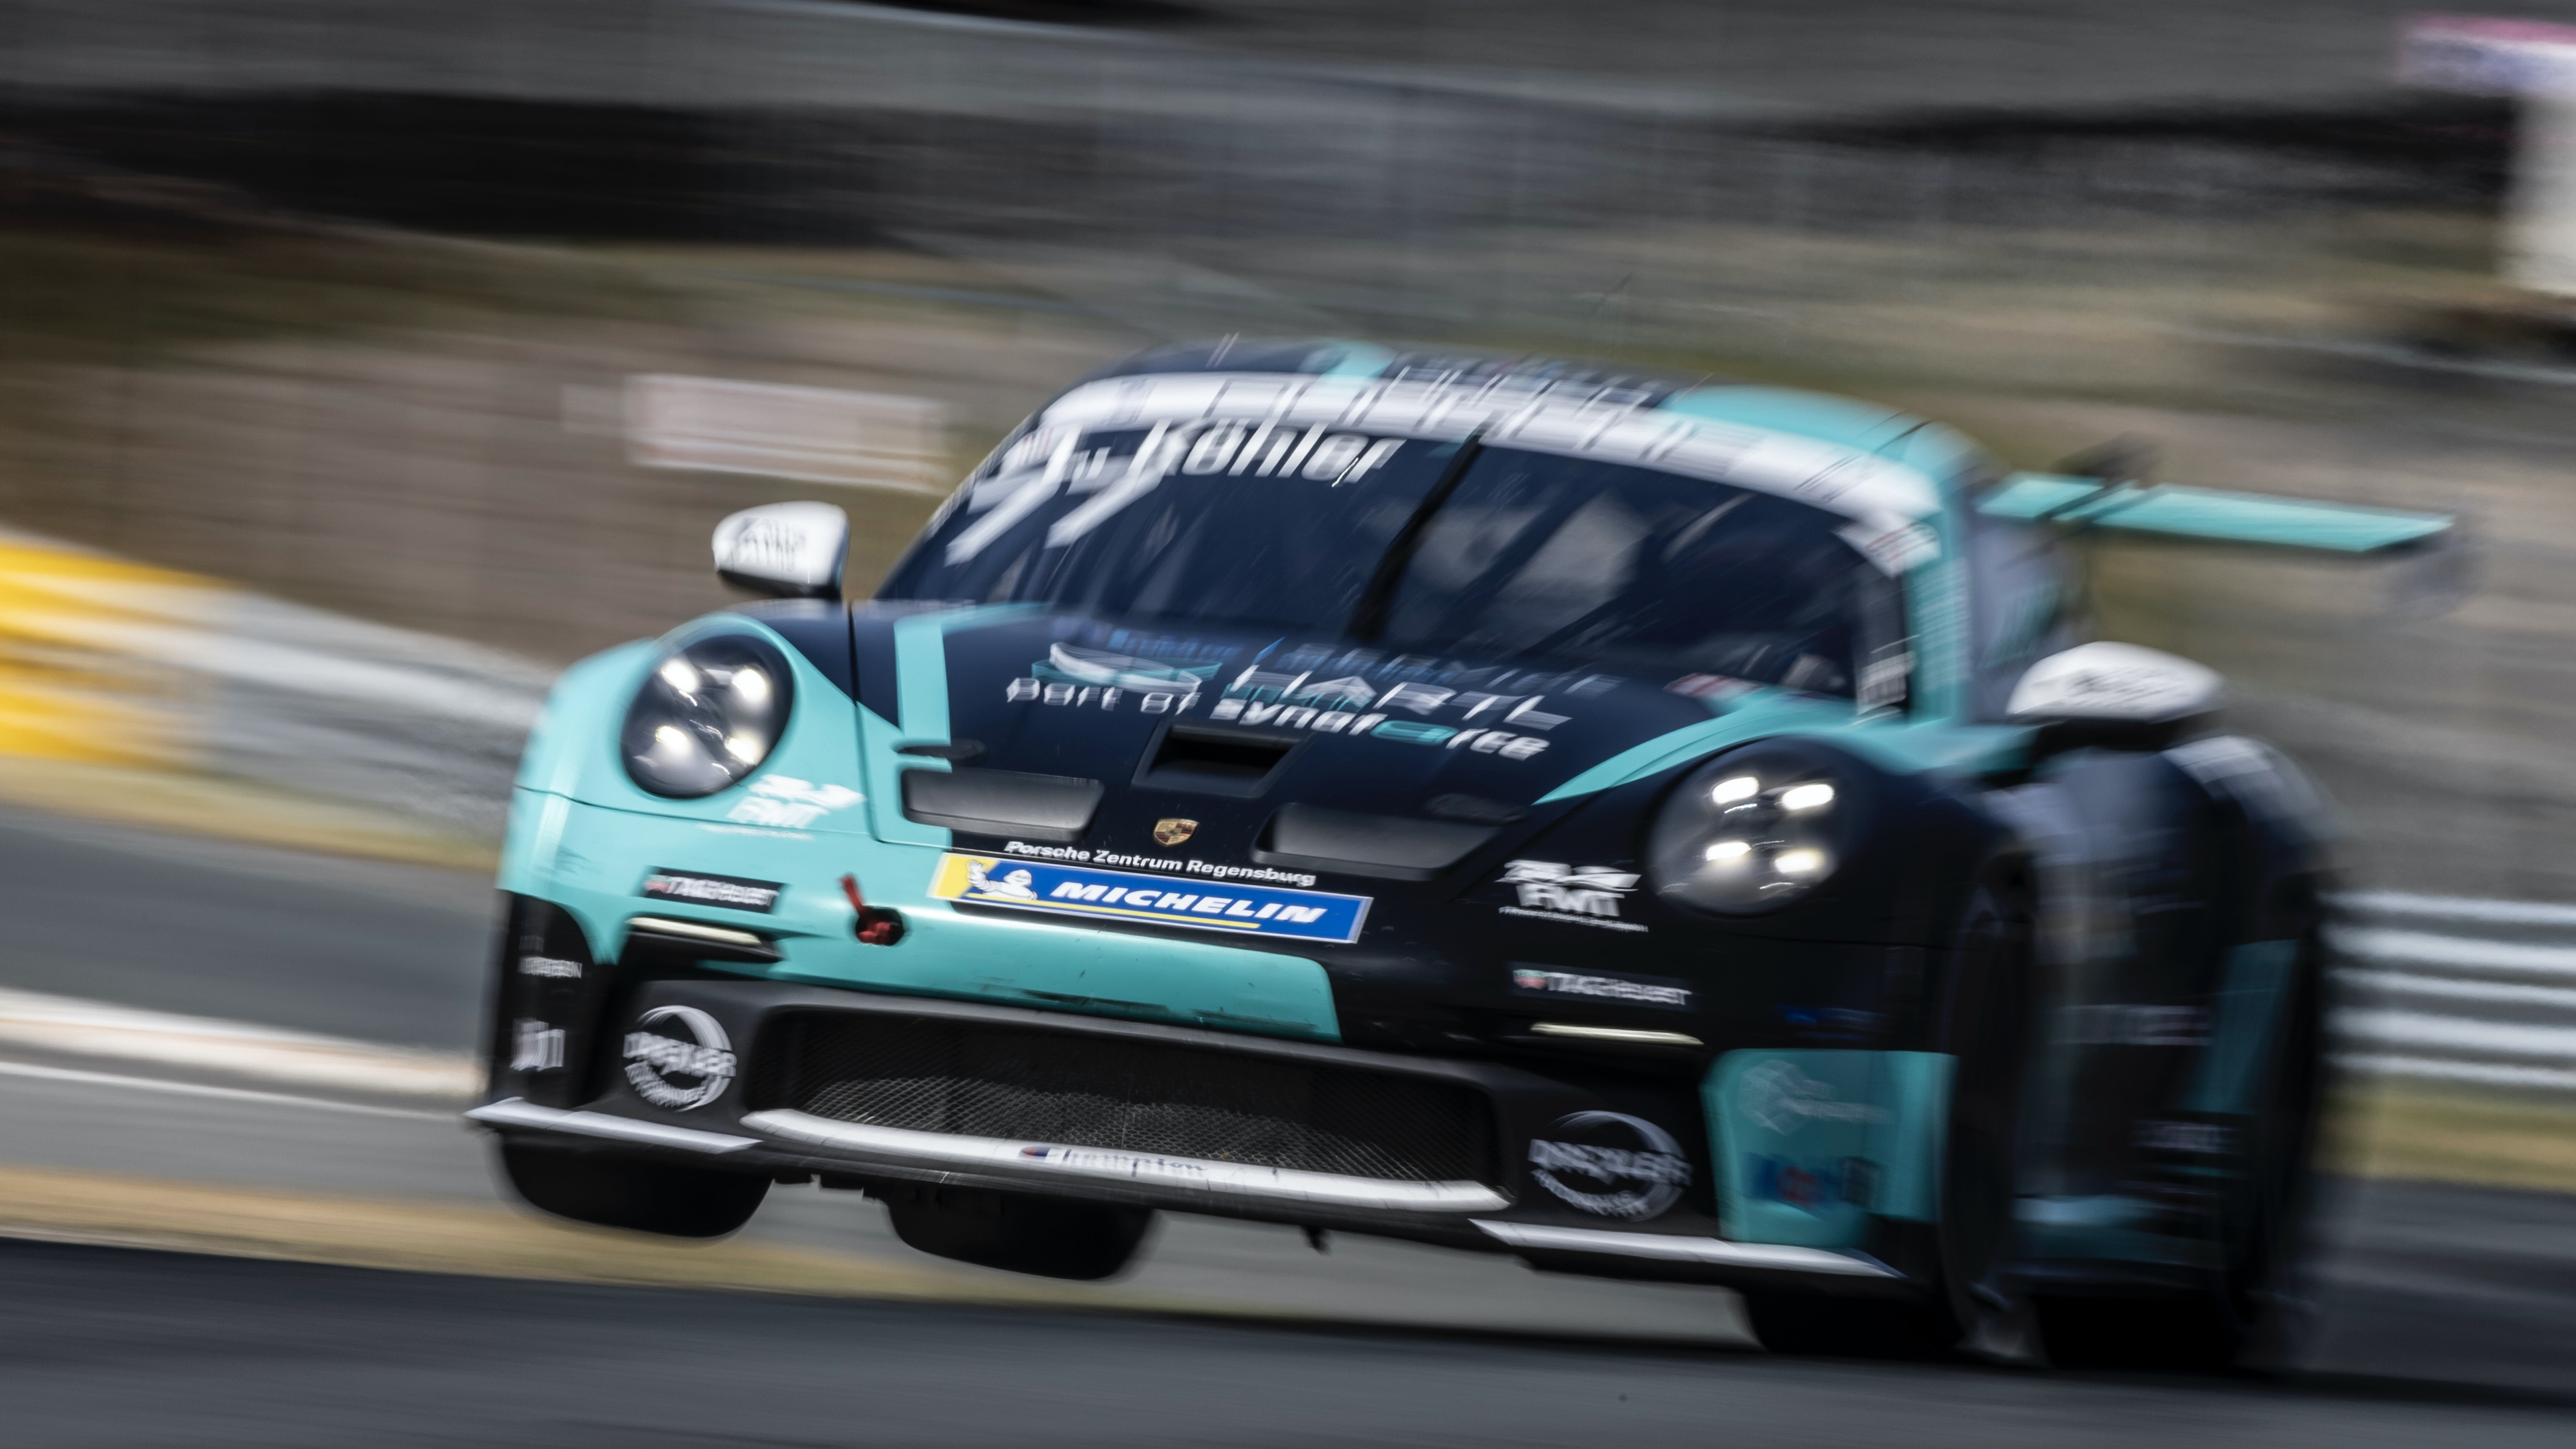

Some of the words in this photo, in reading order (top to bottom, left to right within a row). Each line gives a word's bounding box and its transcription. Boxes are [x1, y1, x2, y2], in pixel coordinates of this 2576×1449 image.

[1006, 677, 1124, 712] part
[1140, 692, 1203, 716] of
[1004, 840, 1091, 862] Porsche
[1092, 850, 1183, 872] Zentrum
[1186, 859, 1317, 887] Regensburg
[1050, 881, 1327, 924] MICHELIN
